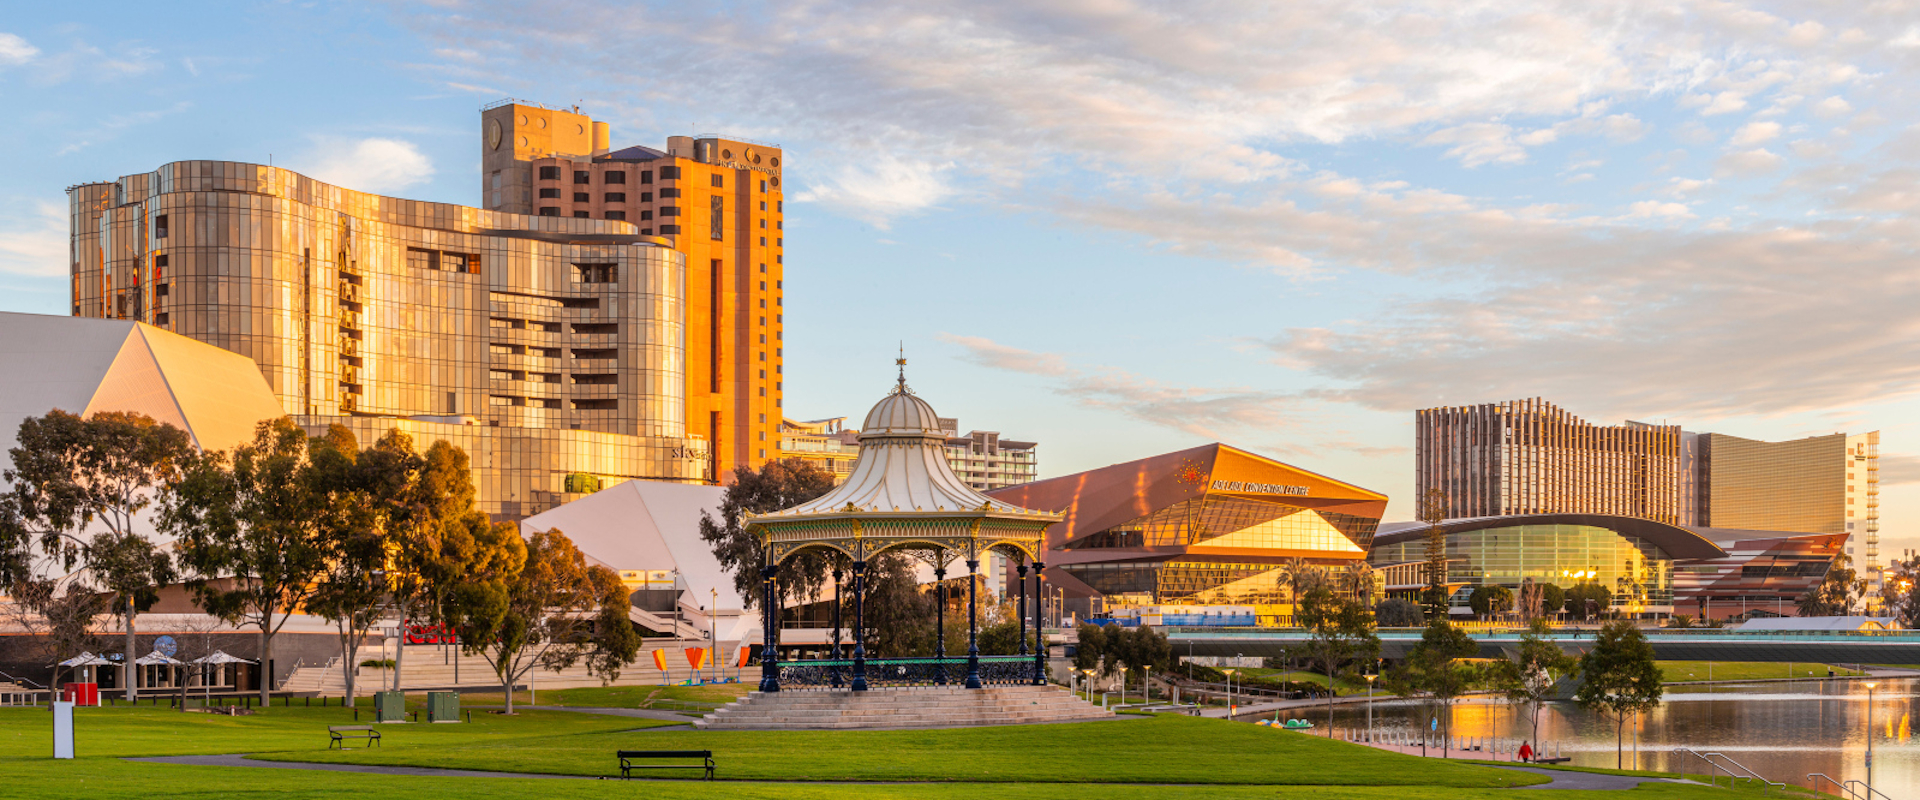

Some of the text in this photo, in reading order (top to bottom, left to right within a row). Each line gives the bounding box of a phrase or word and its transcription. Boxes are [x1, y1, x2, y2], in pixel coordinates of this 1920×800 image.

[1212, 480, 1310, 496] ADELAIDE CONVENTION CENTRE
